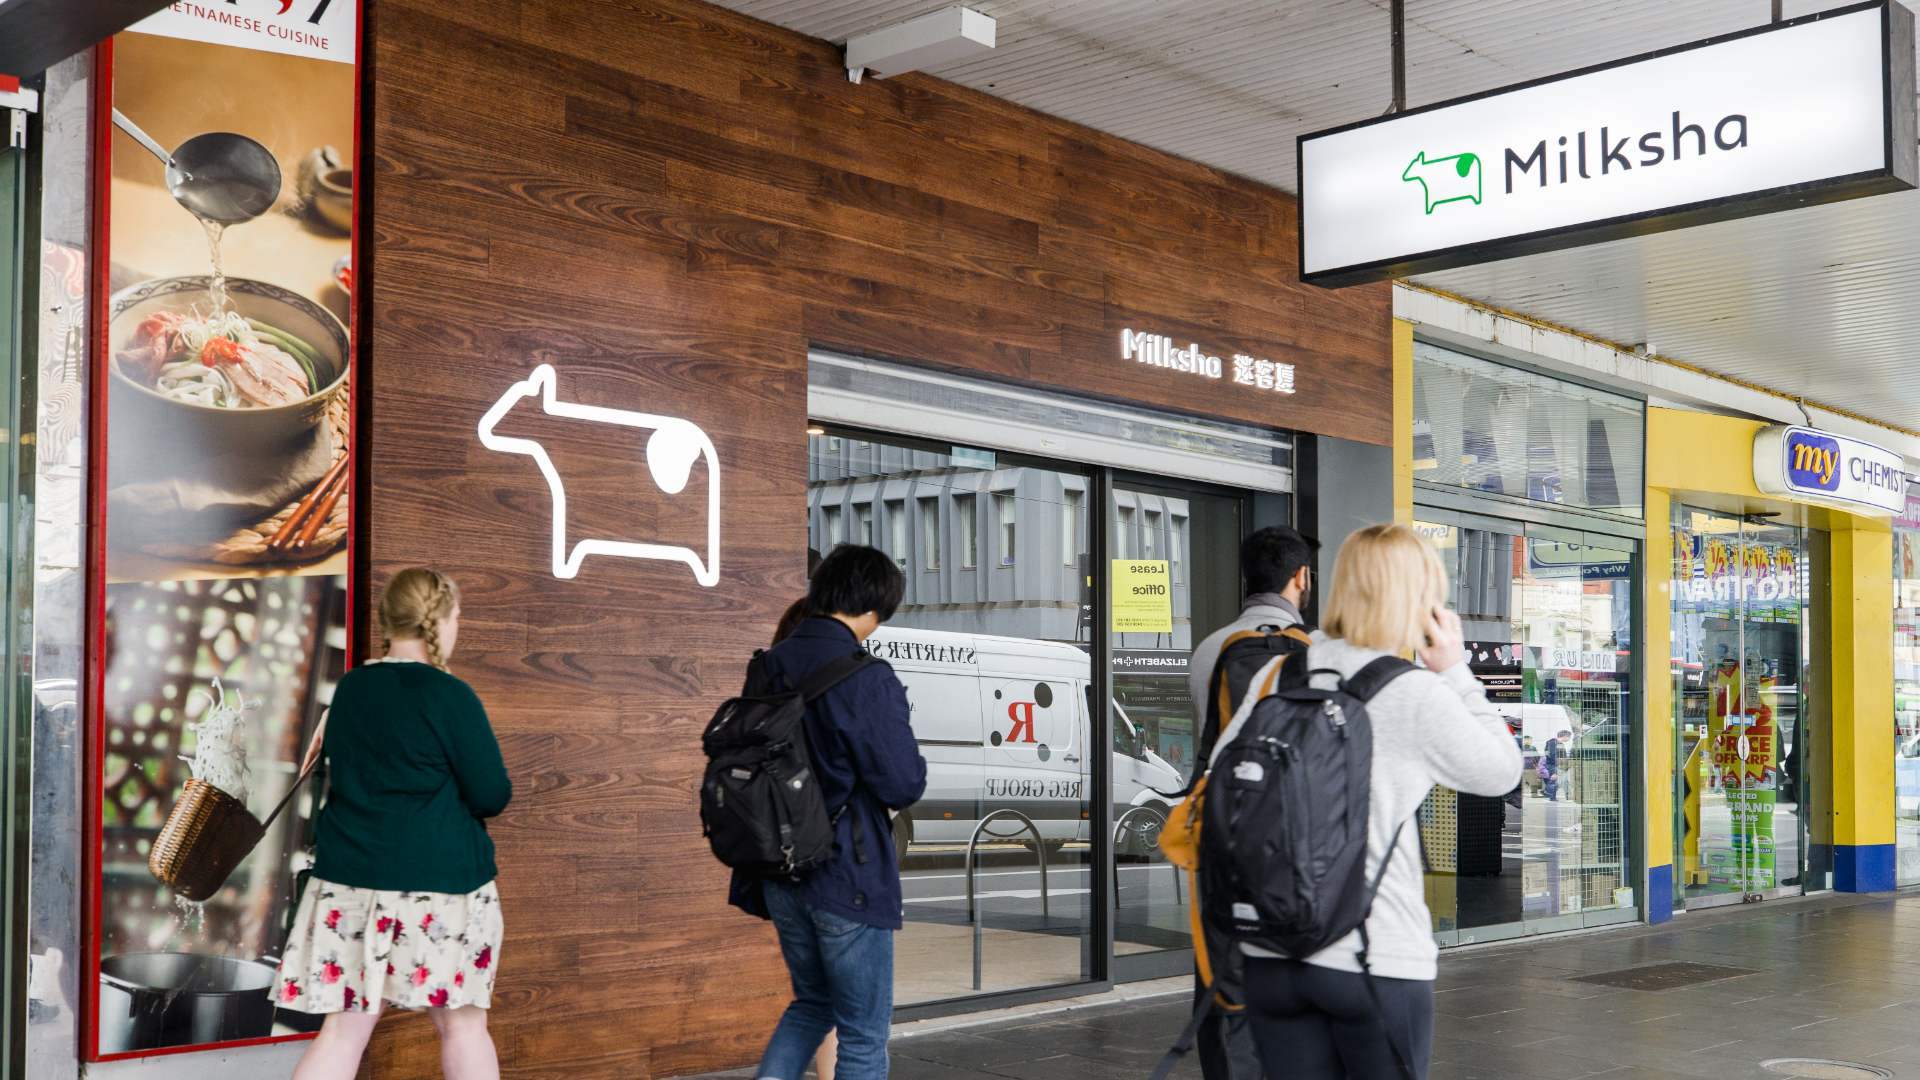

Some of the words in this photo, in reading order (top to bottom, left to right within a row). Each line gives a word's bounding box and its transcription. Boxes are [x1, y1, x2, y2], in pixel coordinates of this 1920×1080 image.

[168, 1, 261, 32] ETNAMESE
[267, 24, 329, 50] CUISINE
[1504, 110, 1748, 195] Milksha
[1121, 327, 1223, 379] Milksha
[1232, 353, 1296, 394] 迷客夏
[1794, 443, 1839, 485] my
[1850, 456, 1907, 495] CHEMIST
